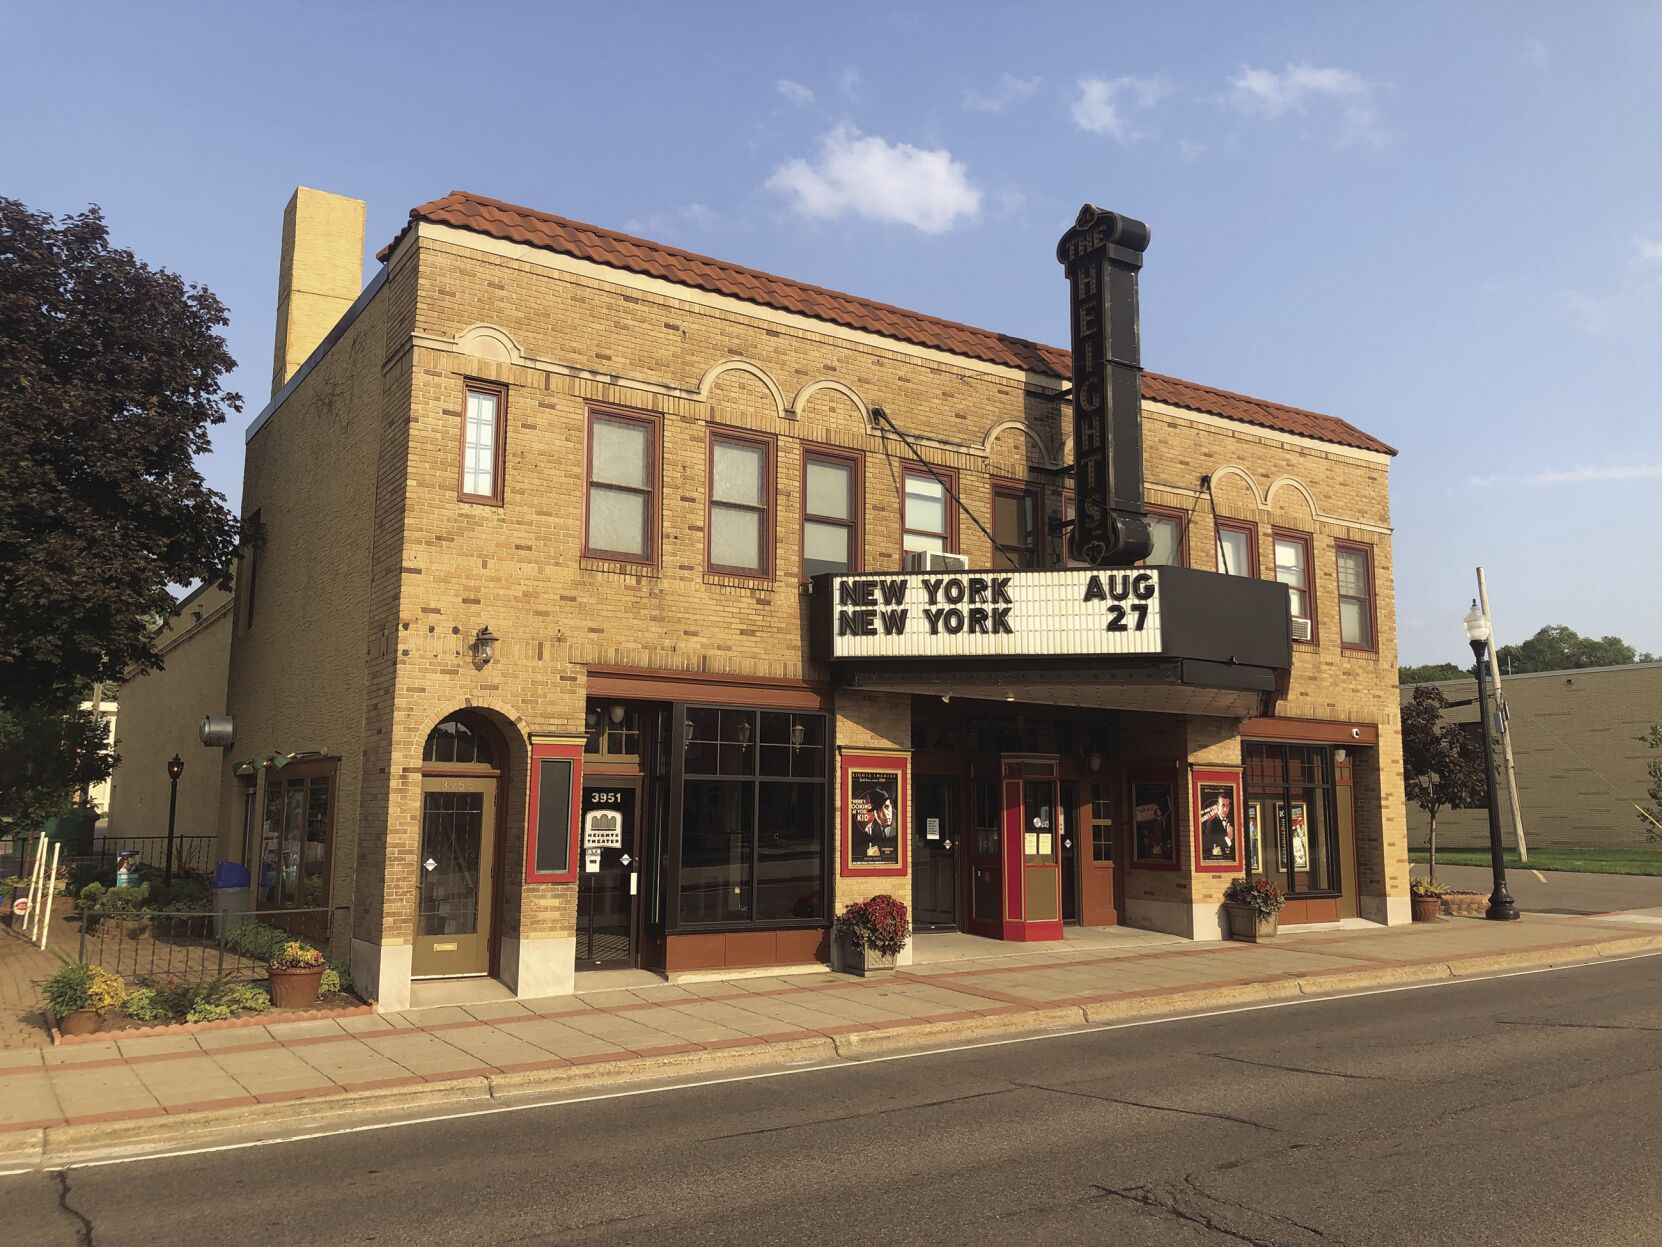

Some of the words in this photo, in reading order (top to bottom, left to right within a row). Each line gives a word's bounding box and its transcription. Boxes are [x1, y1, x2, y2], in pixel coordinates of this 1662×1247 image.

[1066, 224, 1107, 260] THE
[1078, 263, 1101, 528] HEIGHTS
[838, 579, 908, 606] NEW
[921, 577, 1013, 605] YORK
[1083, 573, 1156, 602] AUG
[838, 609, 908, 636] NEW
[921, 607, 1014, 636] YORK
[1106, 603, 1150, 632] 27
[591, 792, 621, 803] 3951
